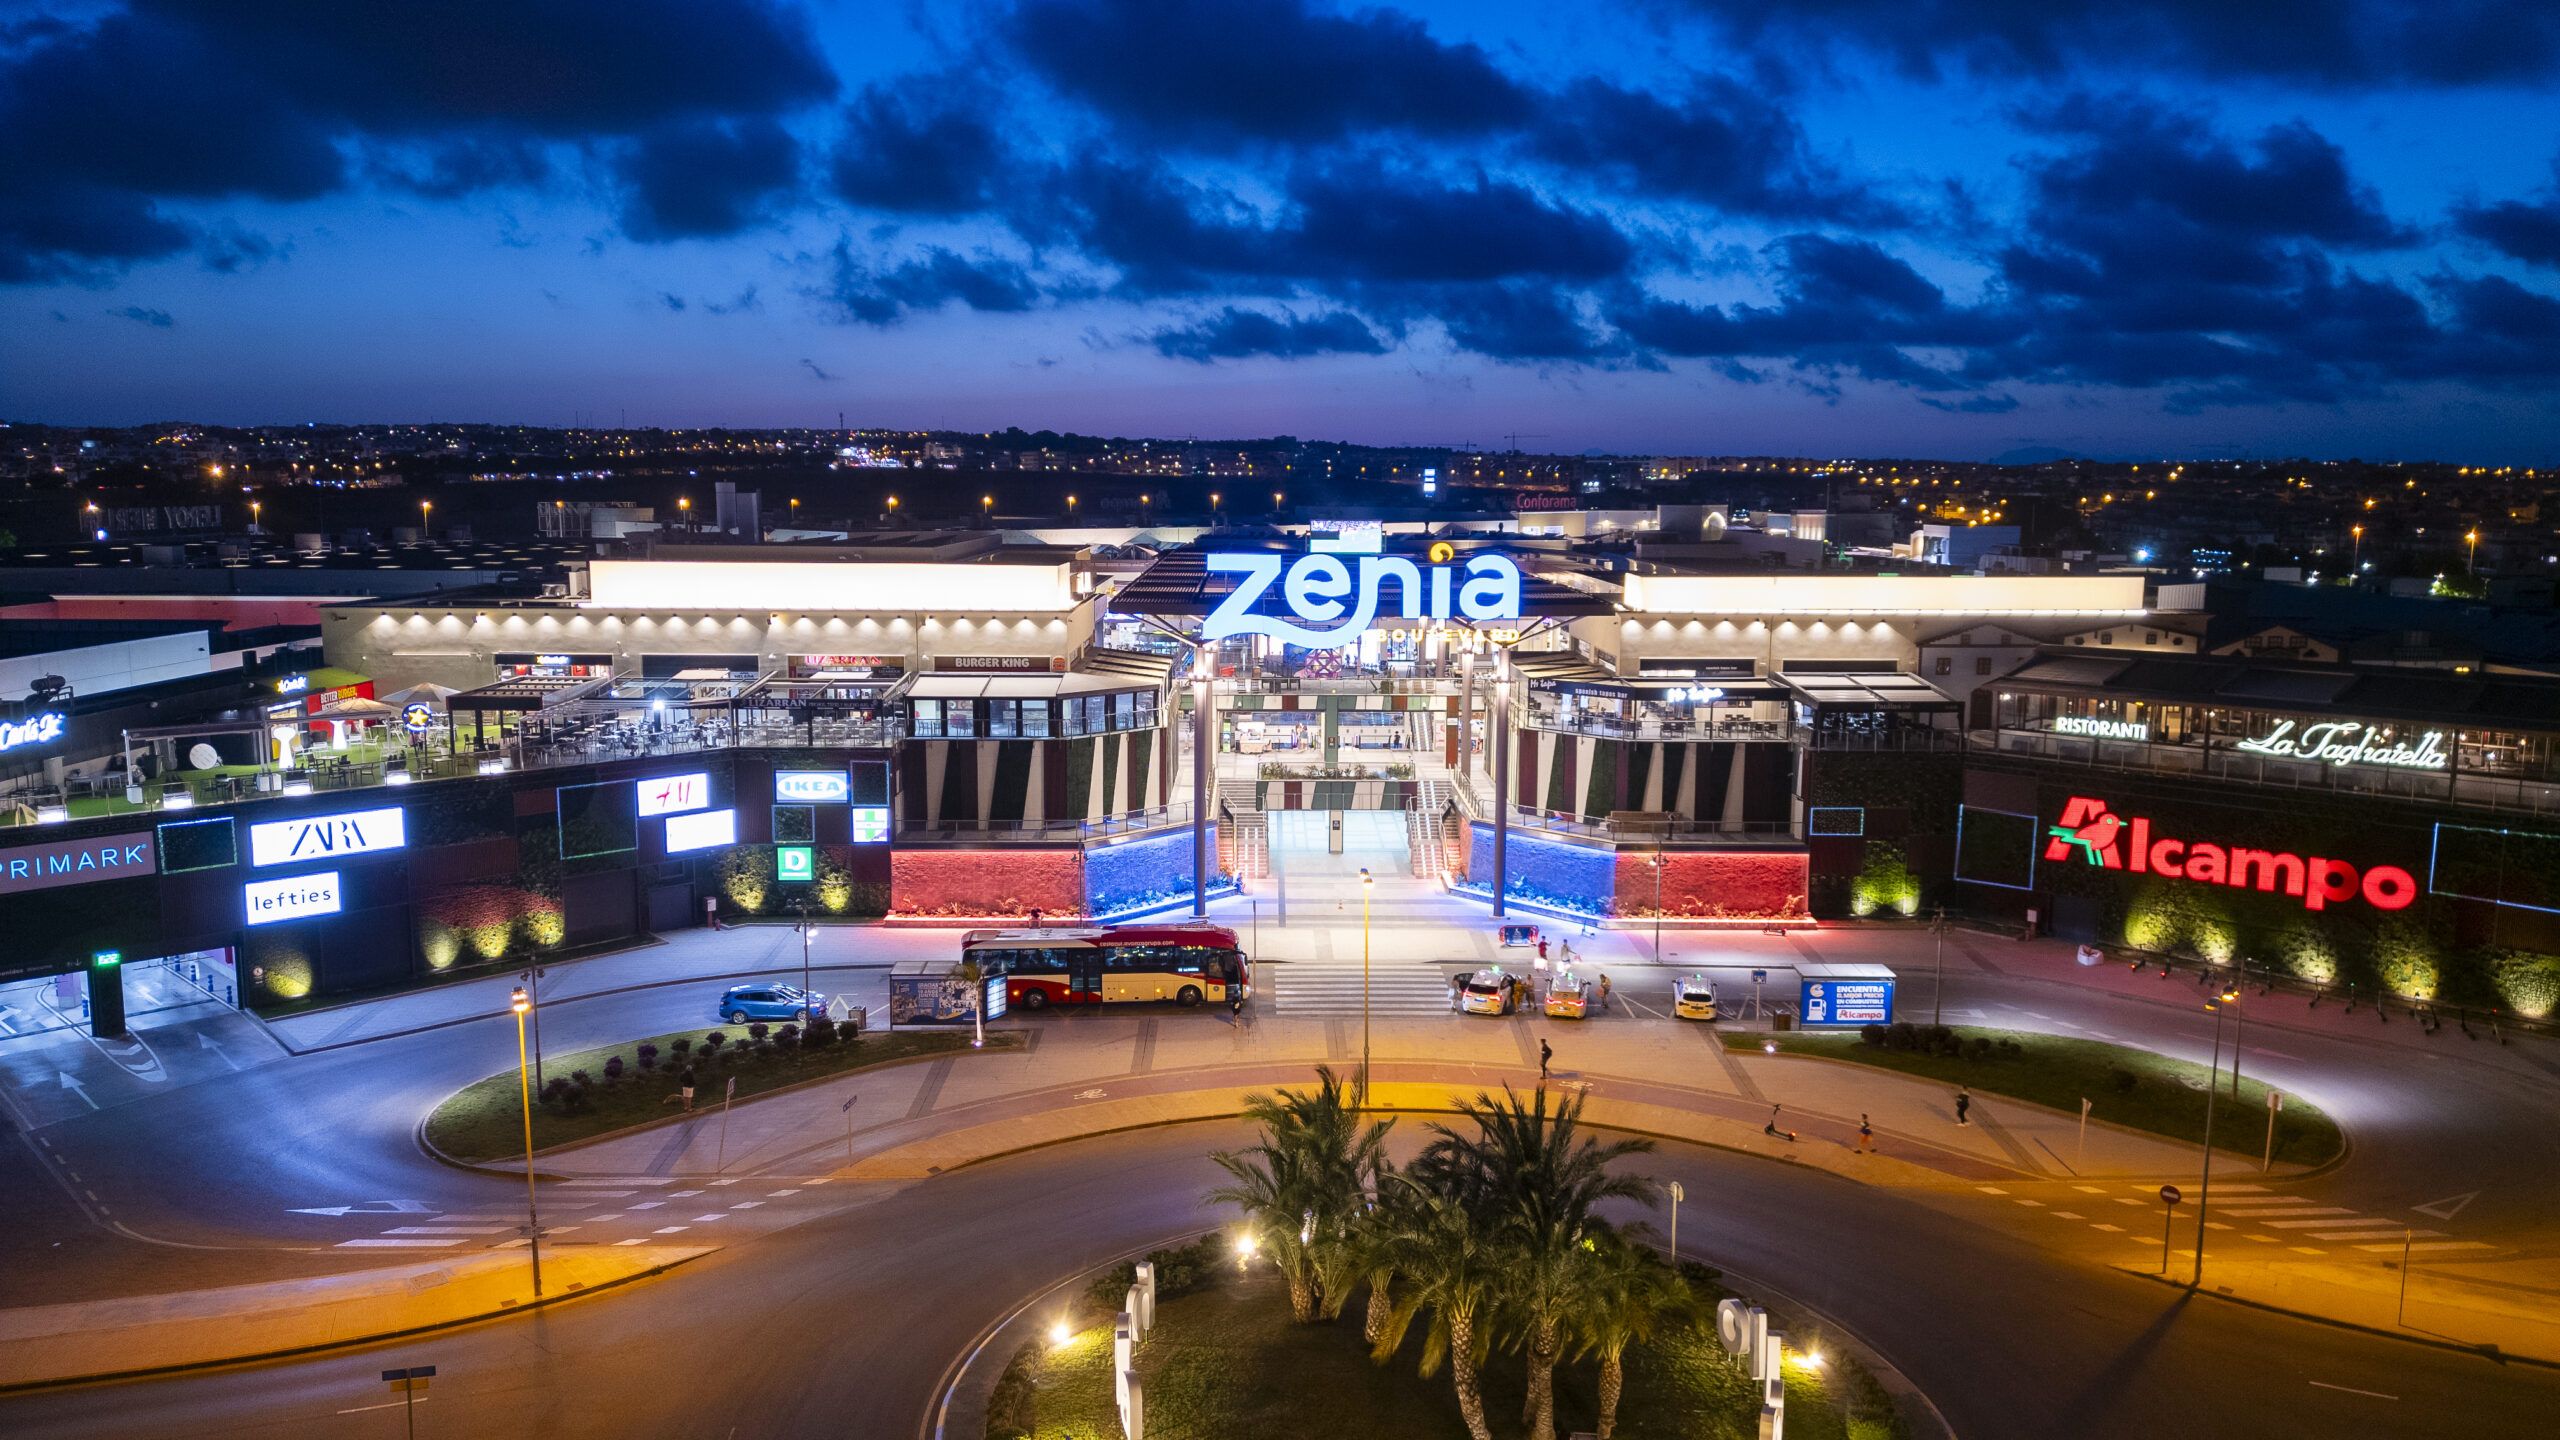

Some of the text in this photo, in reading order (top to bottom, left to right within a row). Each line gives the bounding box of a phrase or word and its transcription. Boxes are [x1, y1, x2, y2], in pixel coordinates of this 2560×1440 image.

[1516, 493, 1577, 509] Conforama
[1378, 628, 1521, 643] BOULEVARD
[955, 657, 1030, 668] BURGER KING
[320, 691, 338, 704] BETTER
[1575, 688, 1597, 696] spanish
[1617, 691, 1628, 699] bar
[749, 699, 807, 707] LIZARRAN
[2056, 717, 2147, 741] RISTORANTI
[2238, 720, 2447, 769] La Tagliatella
[784, 781, 841, 791] IKEA
[288, 818, 366, 857] ZARA
[784, 851, 806, 870] D
[2044, 796, 2417, 911] Alcampo
[254, 888, 331, 912] lefties
[1839, 1010, 1882, 1020] Alcampo
